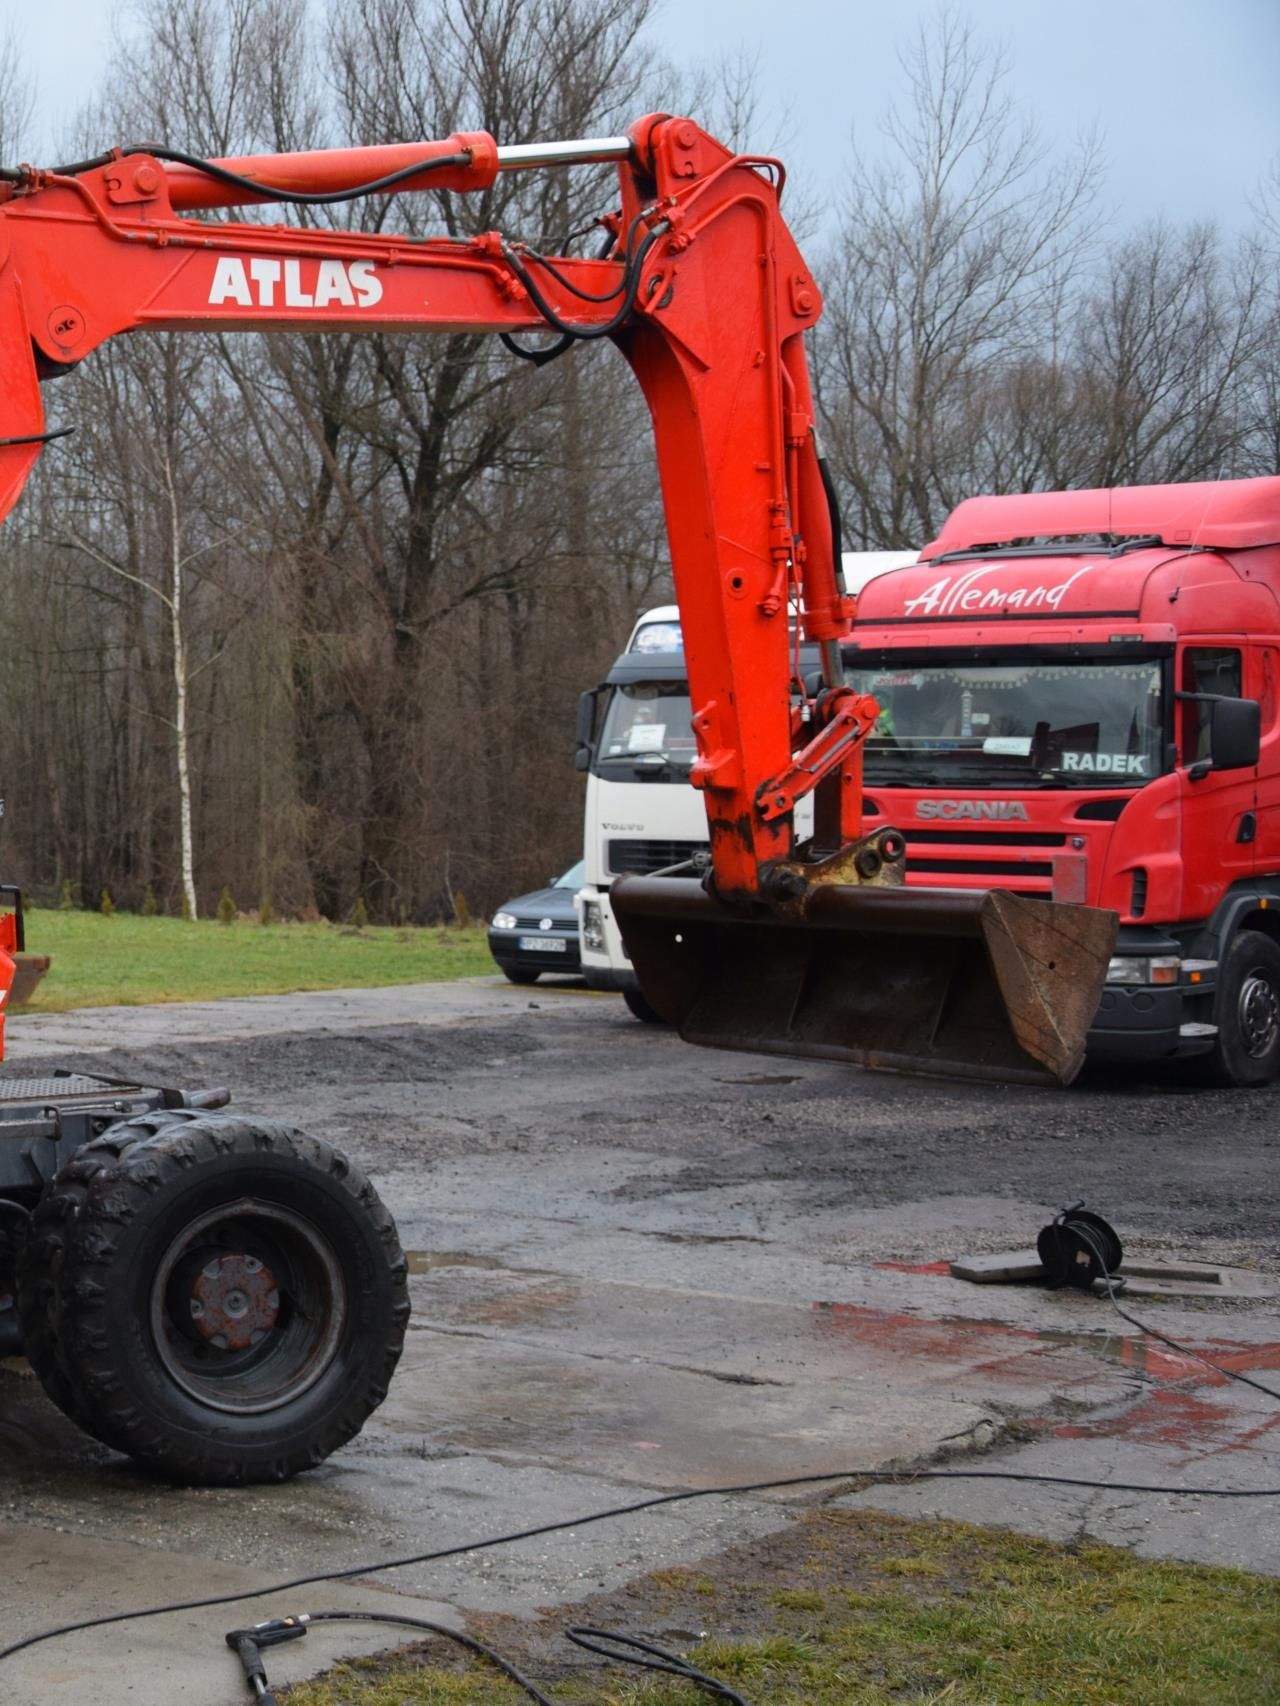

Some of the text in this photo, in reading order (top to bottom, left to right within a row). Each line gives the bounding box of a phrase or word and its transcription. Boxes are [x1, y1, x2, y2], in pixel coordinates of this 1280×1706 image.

[208, 257, 383, 307] ATLAS
[904, 564, 1095, 616] Allemand
[1062, 752, 1150, 774] RADEK
[916, 799, 1030, 821] SCANIA
[601, 823, 645, 832] VOLVO
